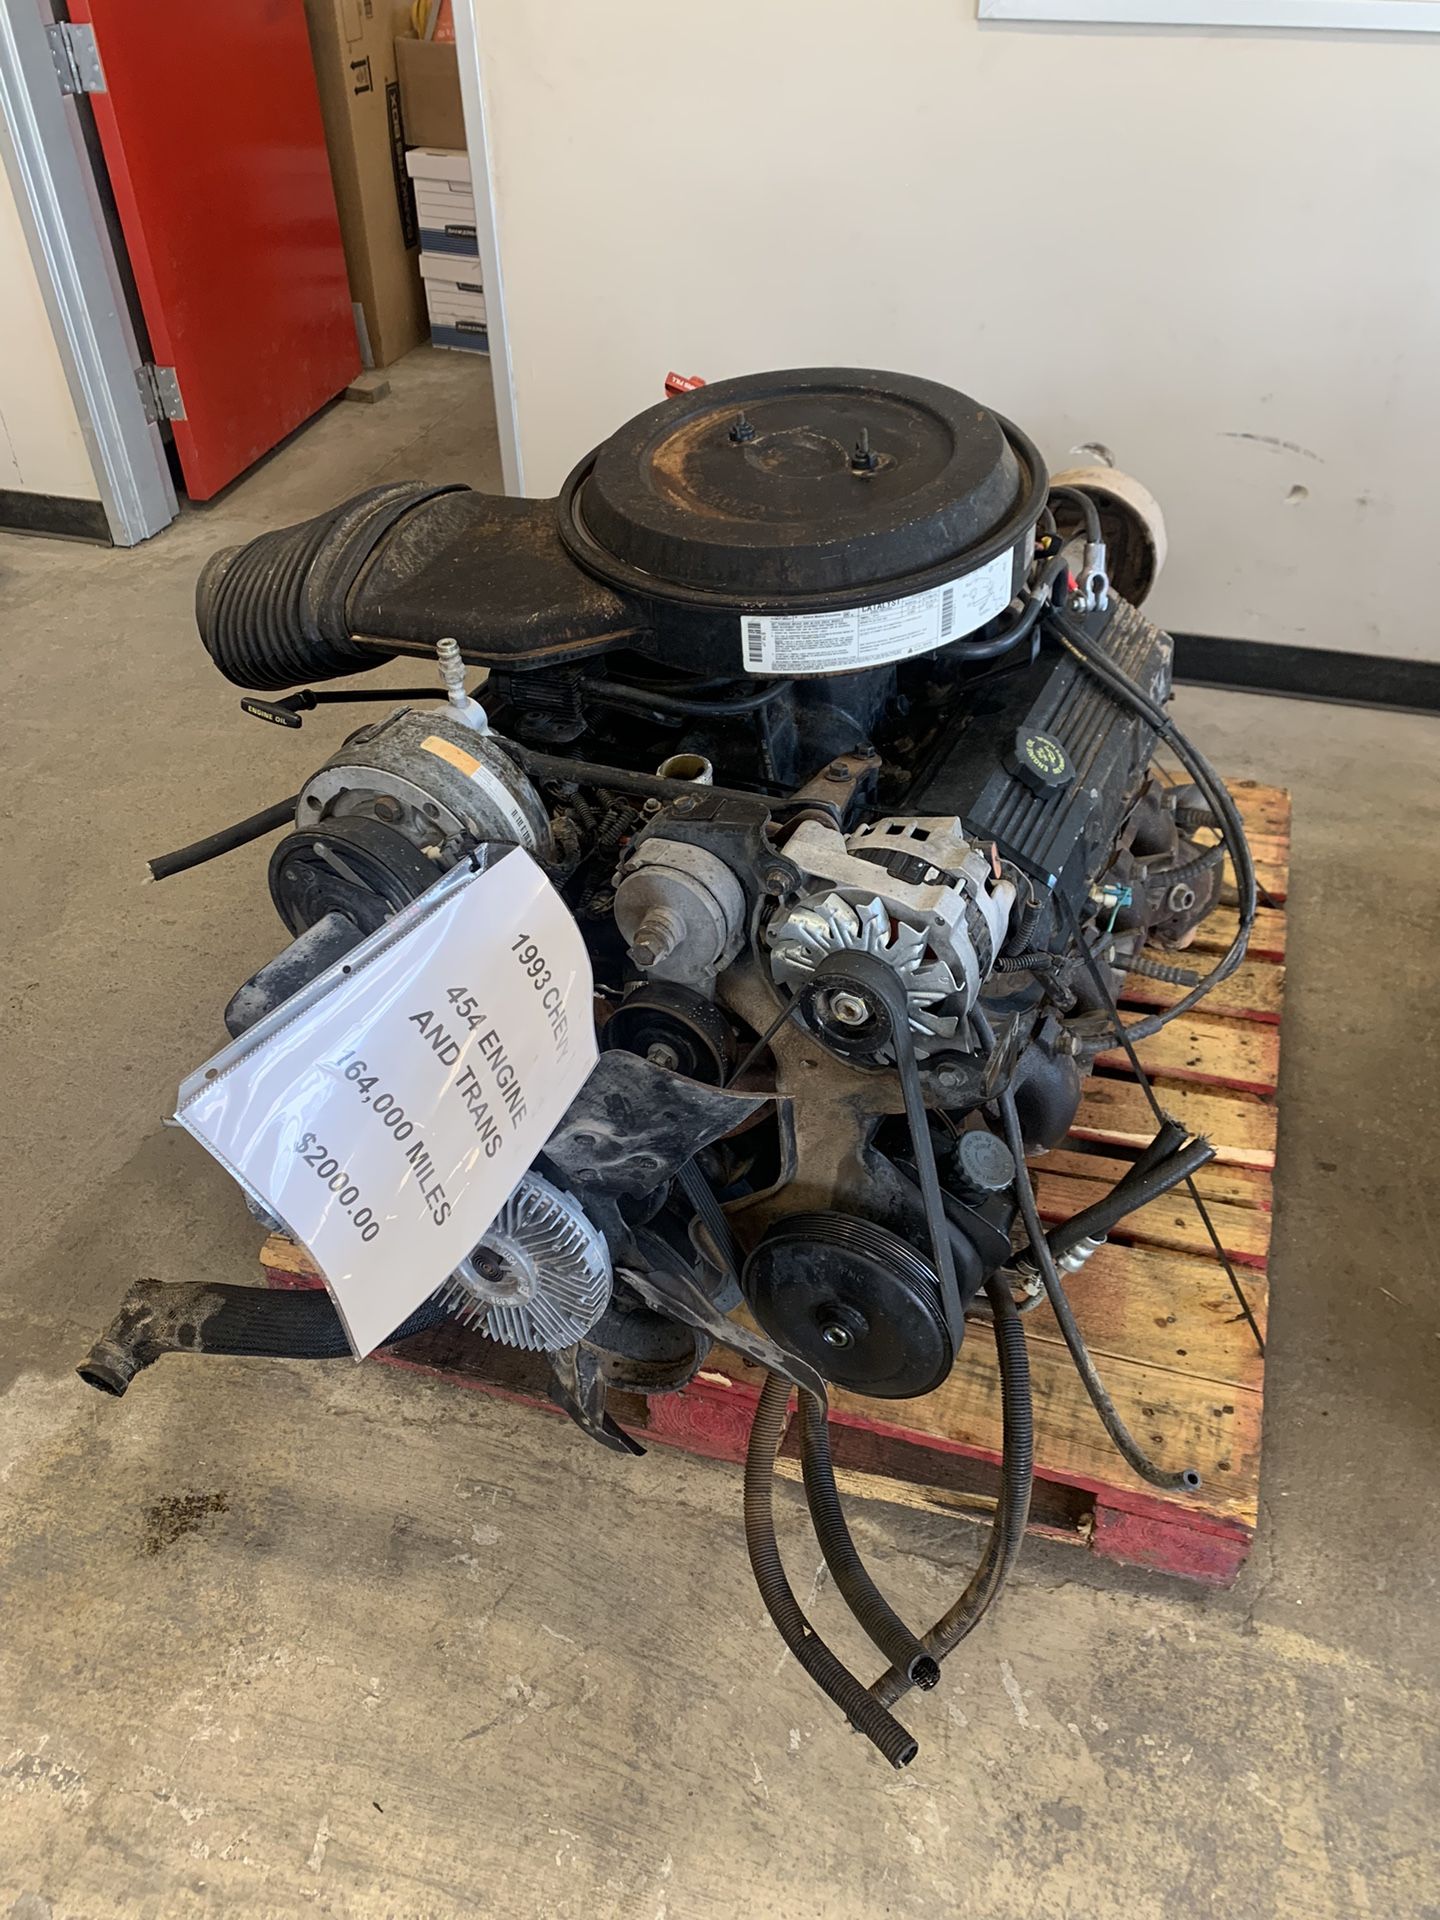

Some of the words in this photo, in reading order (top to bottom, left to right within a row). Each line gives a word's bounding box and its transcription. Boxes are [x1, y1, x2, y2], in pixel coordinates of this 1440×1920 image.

[389, 94, 401, 139] BOX
[248, 705, 273, 720] ENGINE
[274, 716, 288, 725] OIL
[511, 933, 552, 991] 1993
[408, 1010, 461, 1066] AND
[455, 1064, 503, 1158] TRANS
[446, 987, 487, 1031] 454
[477, 1029, 528, 1130] ENGINE
[294, 1132, 380, 1242] $2000.00
[336, 1050, 414, 1141] 164,000
[405, 1140, 451, 1227] MILES
